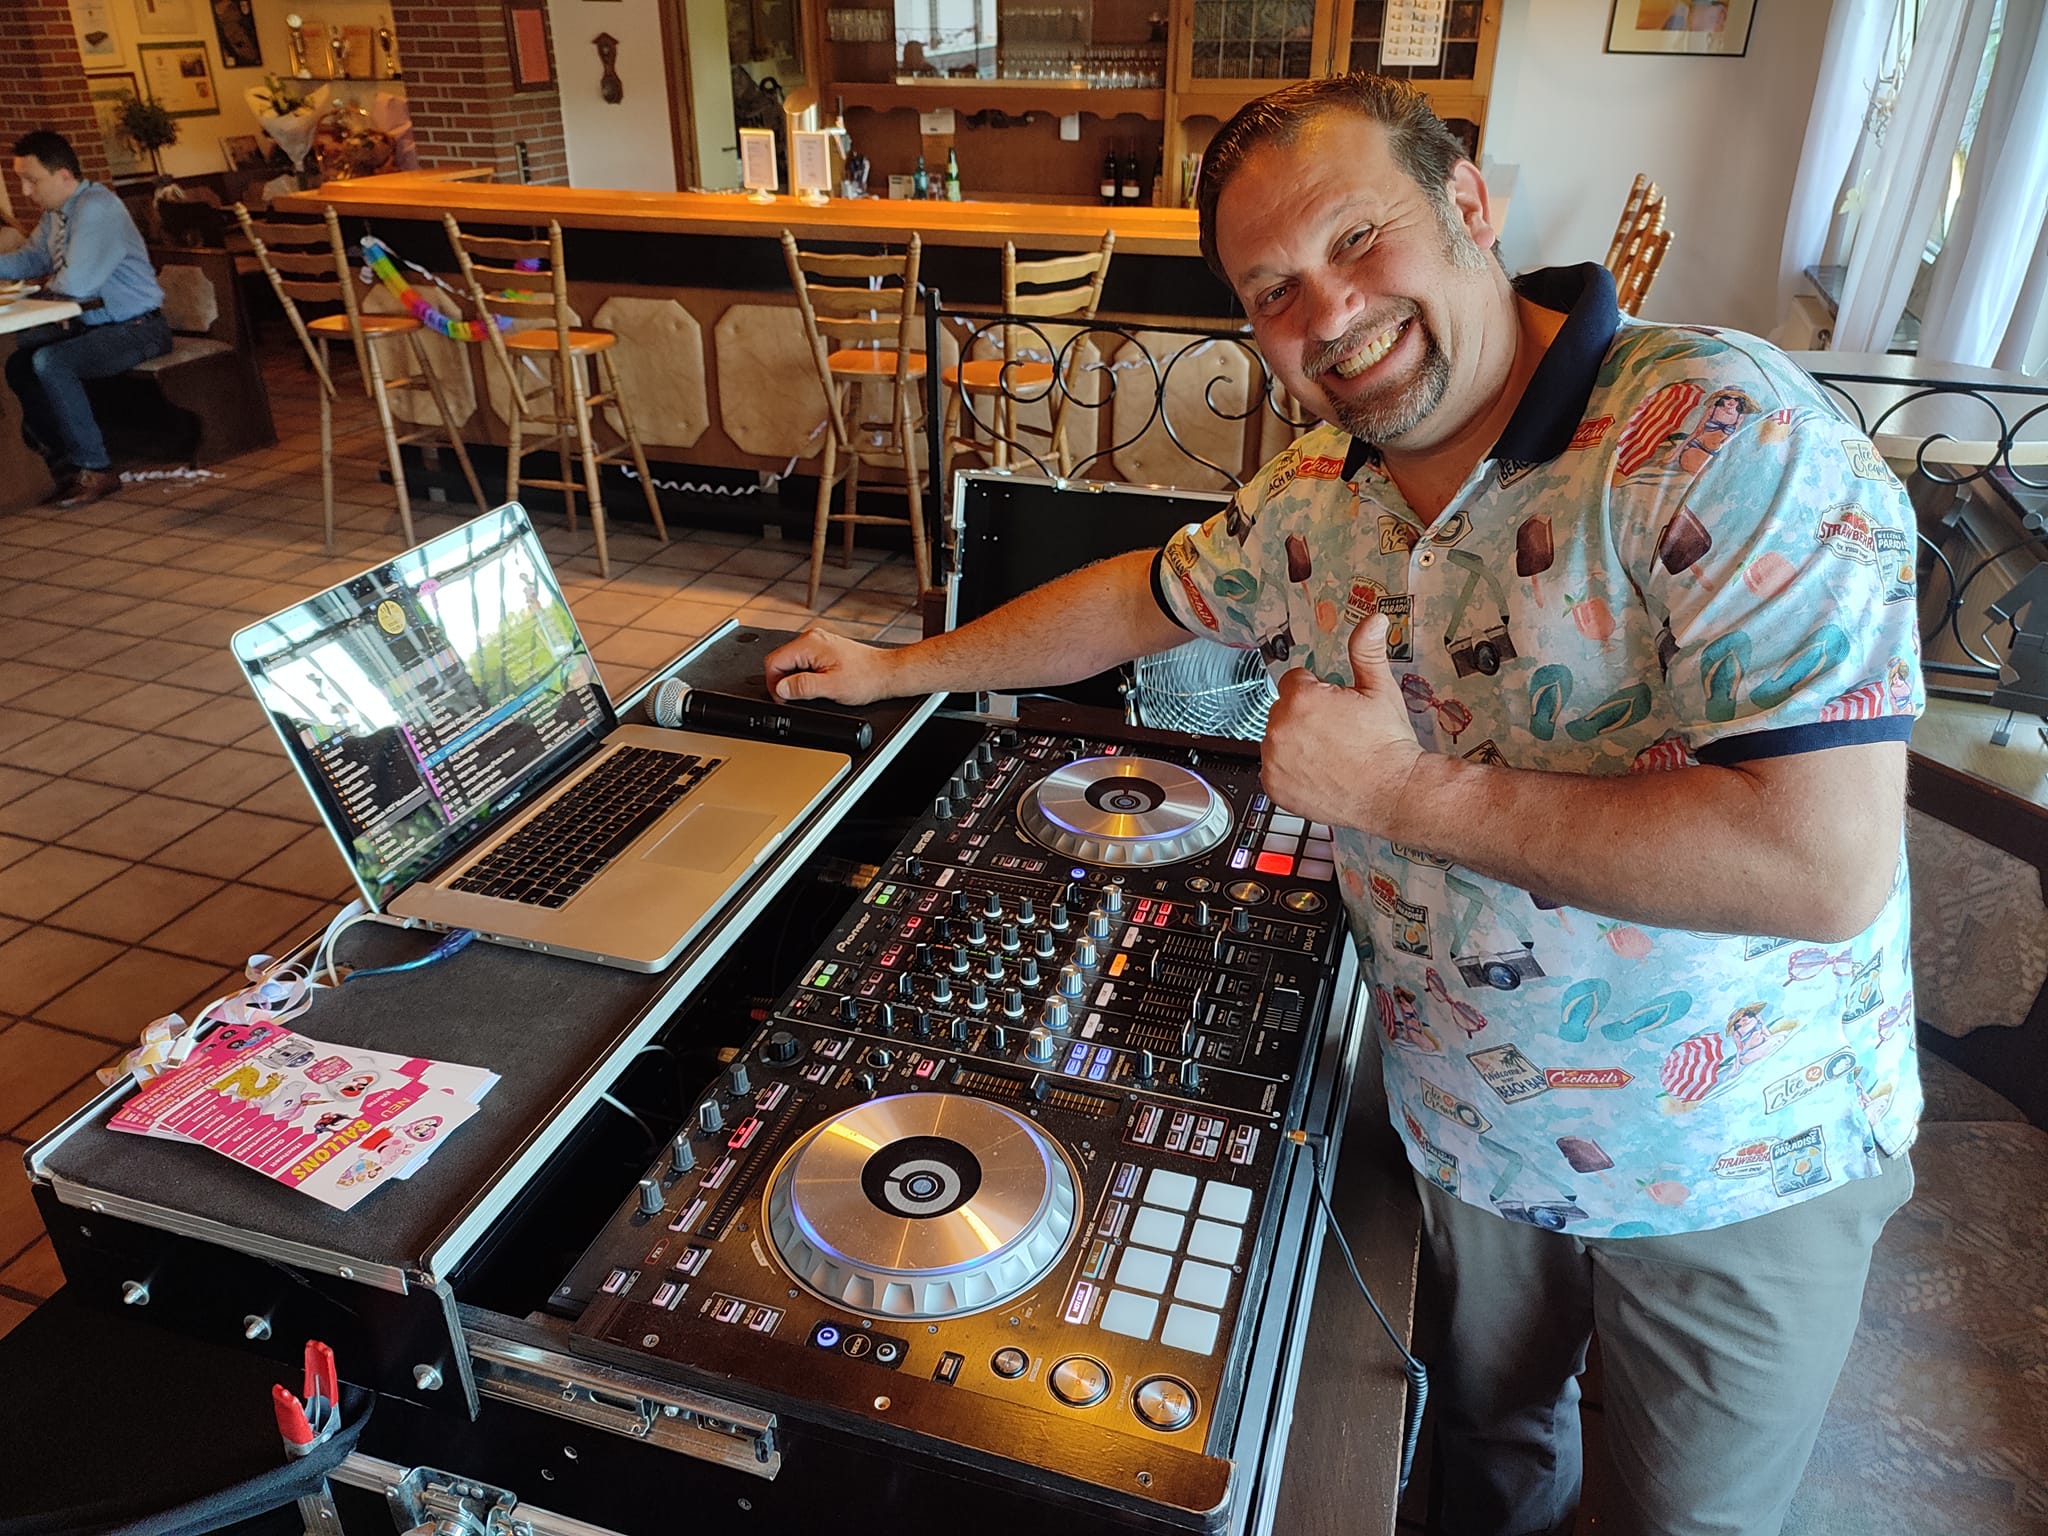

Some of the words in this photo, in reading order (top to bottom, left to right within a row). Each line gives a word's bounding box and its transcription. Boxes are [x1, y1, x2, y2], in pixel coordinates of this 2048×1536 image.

[1819, 520, 1876, 552] STRAWBERR
[835, 911, 871, 953] Pioneer
[1135, 964, 1145, 972] 2
[1107, 1025, 1119, 1034] 3
[1549, 1070, 1619, 1085] Cocktails
[380, 1097, 411, 1118] NEU
[290, 1119, 372, 1181] BALLONS
[1774, 1133, 1818, 1158] PARADISE
[1717, 1151, 1771, 1170] STRAWBERR
[1080, 1235, 1090, 1248] PAD
[1085, 1220, 1095, 1236] MODE
